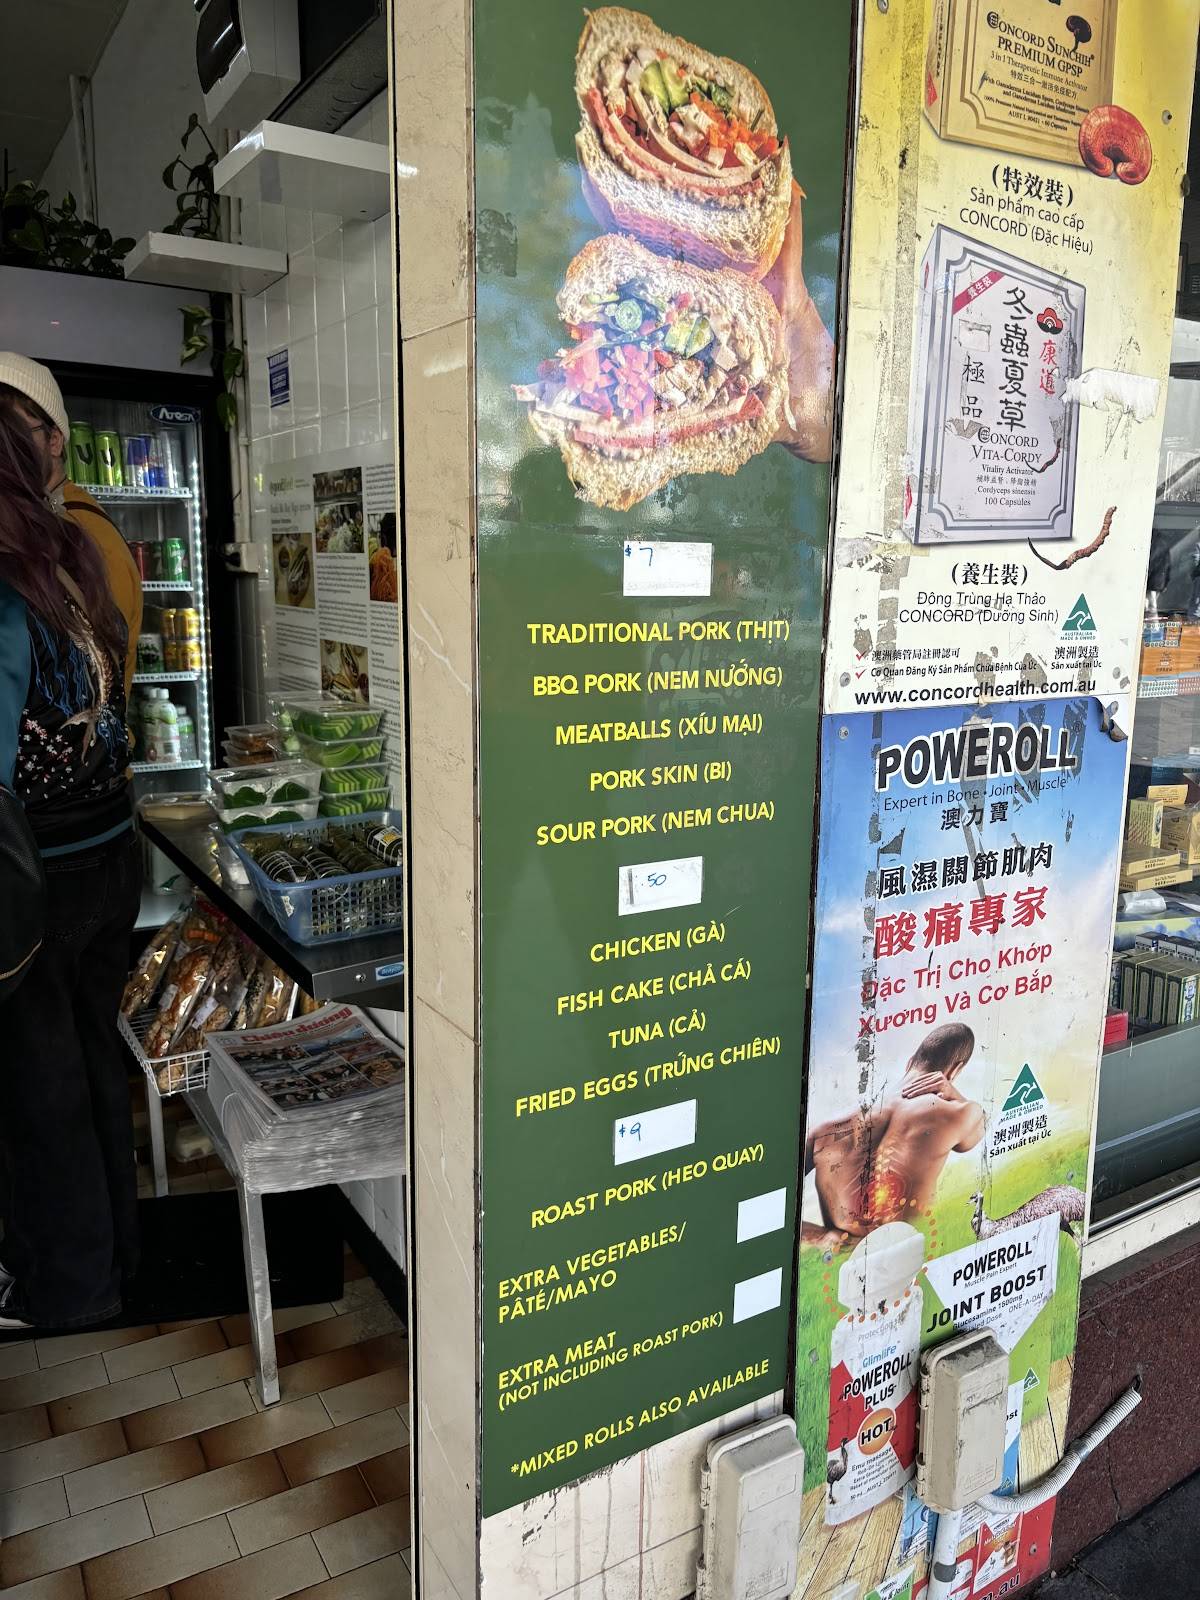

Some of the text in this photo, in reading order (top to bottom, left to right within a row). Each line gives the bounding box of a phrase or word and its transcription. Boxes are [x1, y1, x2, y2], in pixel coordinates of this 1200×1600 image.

[987, 11, 1045, 48] CONCORD
[998, 36, 1082, 77] PREMIUM GPSP
[1008, 56, 1040, 74] Therapeutic
[970, 186, 994, 207] Sản
[959, 207, 1094, 256] CONCORD (Đặc Hiệu)
[972, 445, 1042, 463] VITA-CORDY
[978, 426, 1039, 448] CONCORD
[982, 464, 1005, 476] Vitality
[978, 486, 1011, 495] Cordyceps
[985, 497, 1031, 507] 100 Capsules
[951, 562, 1029, 587] (養生裝)
[899, 609, 1059, 625] CONCORD (Dưỡng Sinh)
[917, 592, 952, 608] Đông
[956, 592, 992, 608] Trùng
[1017, 592, 1046, 605] Thảo
[527, 620, 790, 644] TRADITIONAL PORK (THỊT)
[533, 658, 783, 696] BBQ PORK (NEM NƯỚNG)
[883, 667, 904, 677] Quan
[855, 679, 1096, 705] www.concordhealth.com.au
[555, 712, 763, 745] MEATBALLS (XÍU MẠI)
[878, 726, 1076, 789] POWEROLL
[590, 760, 732, 792] PORK SKIN (BI)
[884, 777, 1067, 812] Expert in Bone Joint Muscle
[536, 800, 776, 846] SOUR PORK (NEM CHUA)
[940, 801, 1009, 831] 澳力寶
[877, 842, 1053, 899] 風濕關節肌肉
[873, 886, 1049, 960] 酸痛專家
[590, 920, 726, 963] CHICKEN (GÀ)
[913, 964, 942, 990] Trị
[949, 957, 992, 981] Cho
[997, 942, 1053, 970] Khớp
[557, 958, 751, 1016] FISH CAKE (CHẢ CÁ)
[945, 991, 972, 1014] Và
[978, 985, 1009, 1005] Cơ
[1015, 969, 1053, 997] Bắp
[608, 1009, 707, 1049] TUNA (CẢ)
[515, 1036, 781, 1118] FRIED EGGS (TRỨNG CHIÊN)
[1005, 1101, 1040, 1116] AUSTRALIAN
[618, 1122, 642, 1142] $9
[531, 1143, 765, 1229] ROAST PORK (HEO QUAY)
[499, 1221, 687, 1299] EXTRA VEGETABLES/
[953, 1241, 1032, 1287] POWEROLL
[964, 1262, 1017, 1289] Muscle Pain Expert
[498, 1269, 617, 1324] PÂTÉ/MAYO
[926, 1291, 985, 1333] JOINT
[990, 1264, 1047, 1304] BOOST
[953, 1305, 997, 1330] Glucosamine
[498, 1331, 617, 1390] EXTRA MEAT
[498, 1311, 724, 1412] (NOT INCLUDING ROAST PORK)
[863, 1345, 897, 1368] Glimlife
[844, 1352, 912, 1399] POWEROLL
[583, 1415, 634, 1450] ROLLS
[638, 1396, 682, 1427] ALSO
[686, 1359, 770, 1406] AVAILABLE
[865, 1384, 895, 1410] PLUS
[861, 1417, 892, 1445] HOT
[851, 1447, 892, 1471] Emu massage
